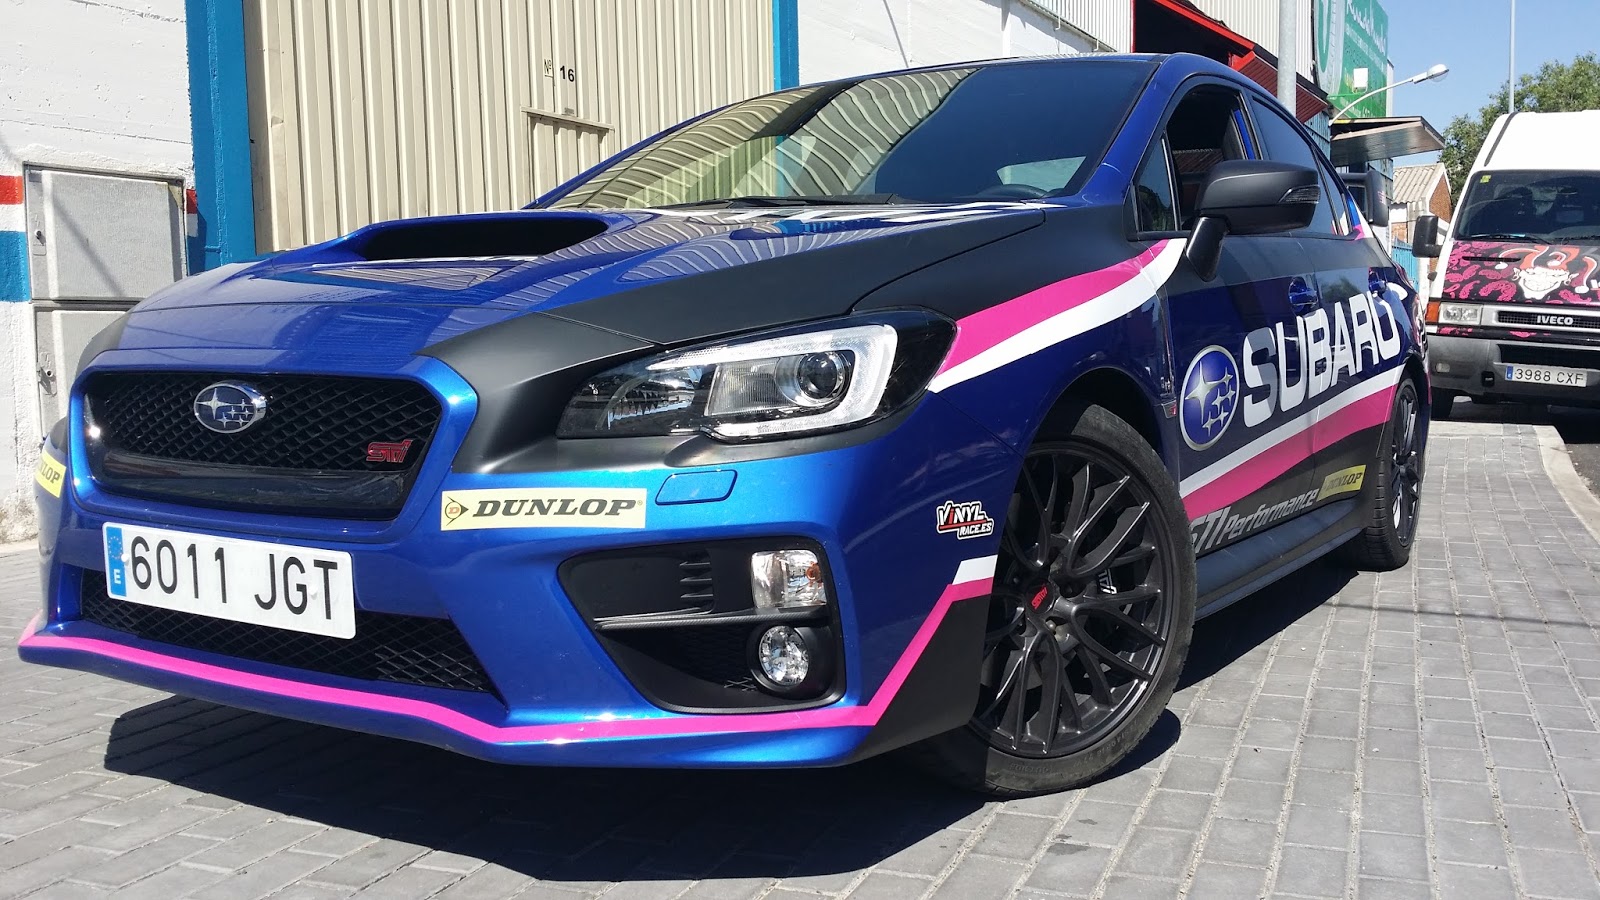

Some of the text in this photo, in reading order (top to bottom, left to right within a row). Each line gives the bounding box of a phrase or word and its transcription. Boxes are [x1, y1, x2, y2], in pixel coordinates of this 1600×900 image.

[560, 65, 575, 82] 16
[1536, 315, 1574, 326] IVECO
[1243, 291, 1401, 428] SUBARU
[1515, 368, 1584, 385] 3988 CXF
[472, 498, 637, 518] DUNLOP
[1221, 488, 1320, 541] Performance
[113, 568, 122, 585] E
[131, 535, 338, 620] 6011 JGT
